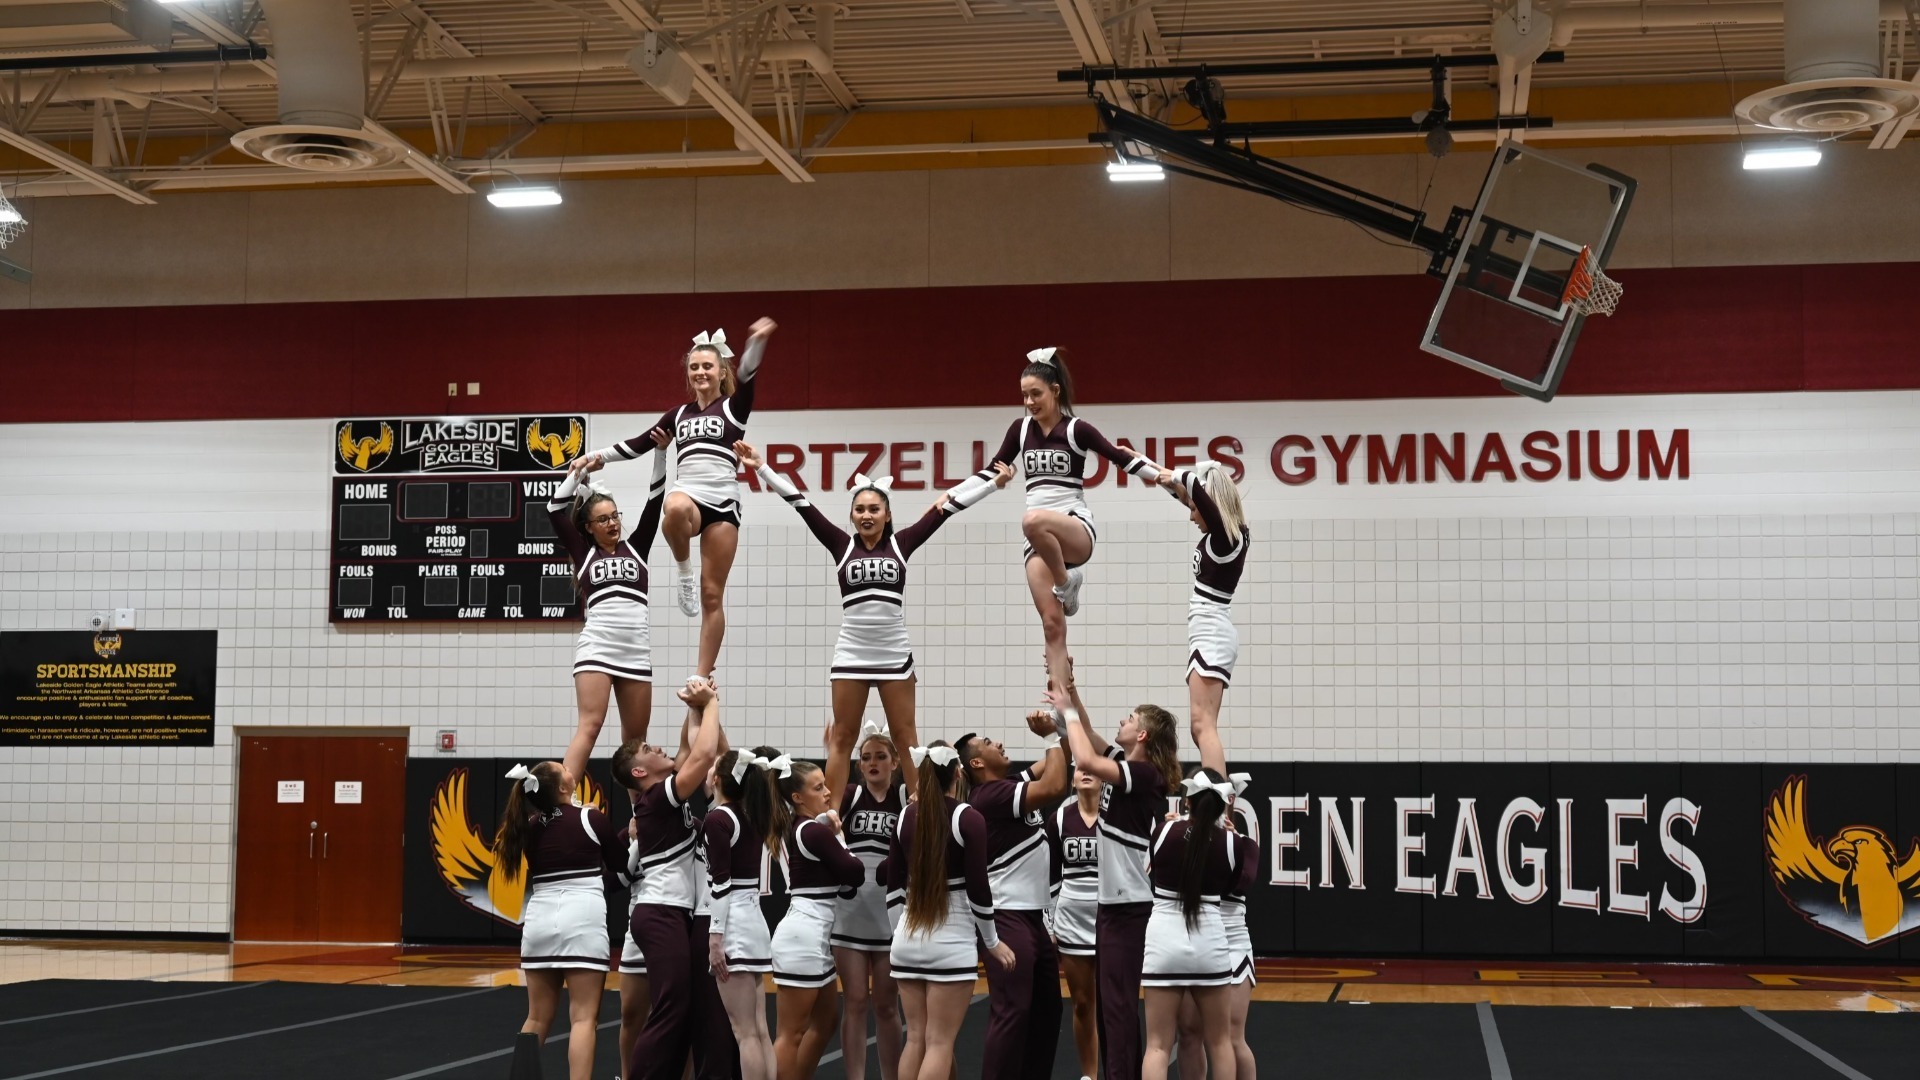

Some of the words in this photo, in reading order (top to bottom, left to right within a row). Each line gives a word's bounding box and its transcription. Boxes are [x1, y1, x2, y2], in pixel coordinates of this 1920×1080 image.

[405, 421, 516, 448] LAKESIDE
[676, 416, 724, 444] GHS
[425, 443, 494, 452] GOLDEN
[424, 452, 495, 468] EAGLES
[736, 440, 1005, 492] RTZELL
[1270, 429, 1690, 486] GYMNASIUM
[1024, 449, 1071, 475] GHS
[345, 483, 388, 499] HOME
[435, 525, 457, 535] POSS
[426, 536, 466, 548] PERIOD
[361, 545, 397, 556] BONUS
[517, 543, 554, 555] BONUS
[340, 565, 374, 577] FOULS
[418, 565, 458, 577] PLAYER
[470, 564, 505, 576] FOULS
[542, 563, 575, 576] FOULS
[589, 557, 639, 585] GHS
[846, 557, 899, 586] GHS
[343, 608, 366, 619] WON
[387, 607, 408, 619] TOL
[458, 607, 486, 618] GAME
[503, 606, 524, 618] TOL
[542, 606, 565, 618] WON
[37, 663, 177, 679] SPORTSMANSHIP
[850, 810, 898, 838] GHS
[1063, 837, 1098, 863] GH
[1394, 794, 1708, 924] EAGLES
